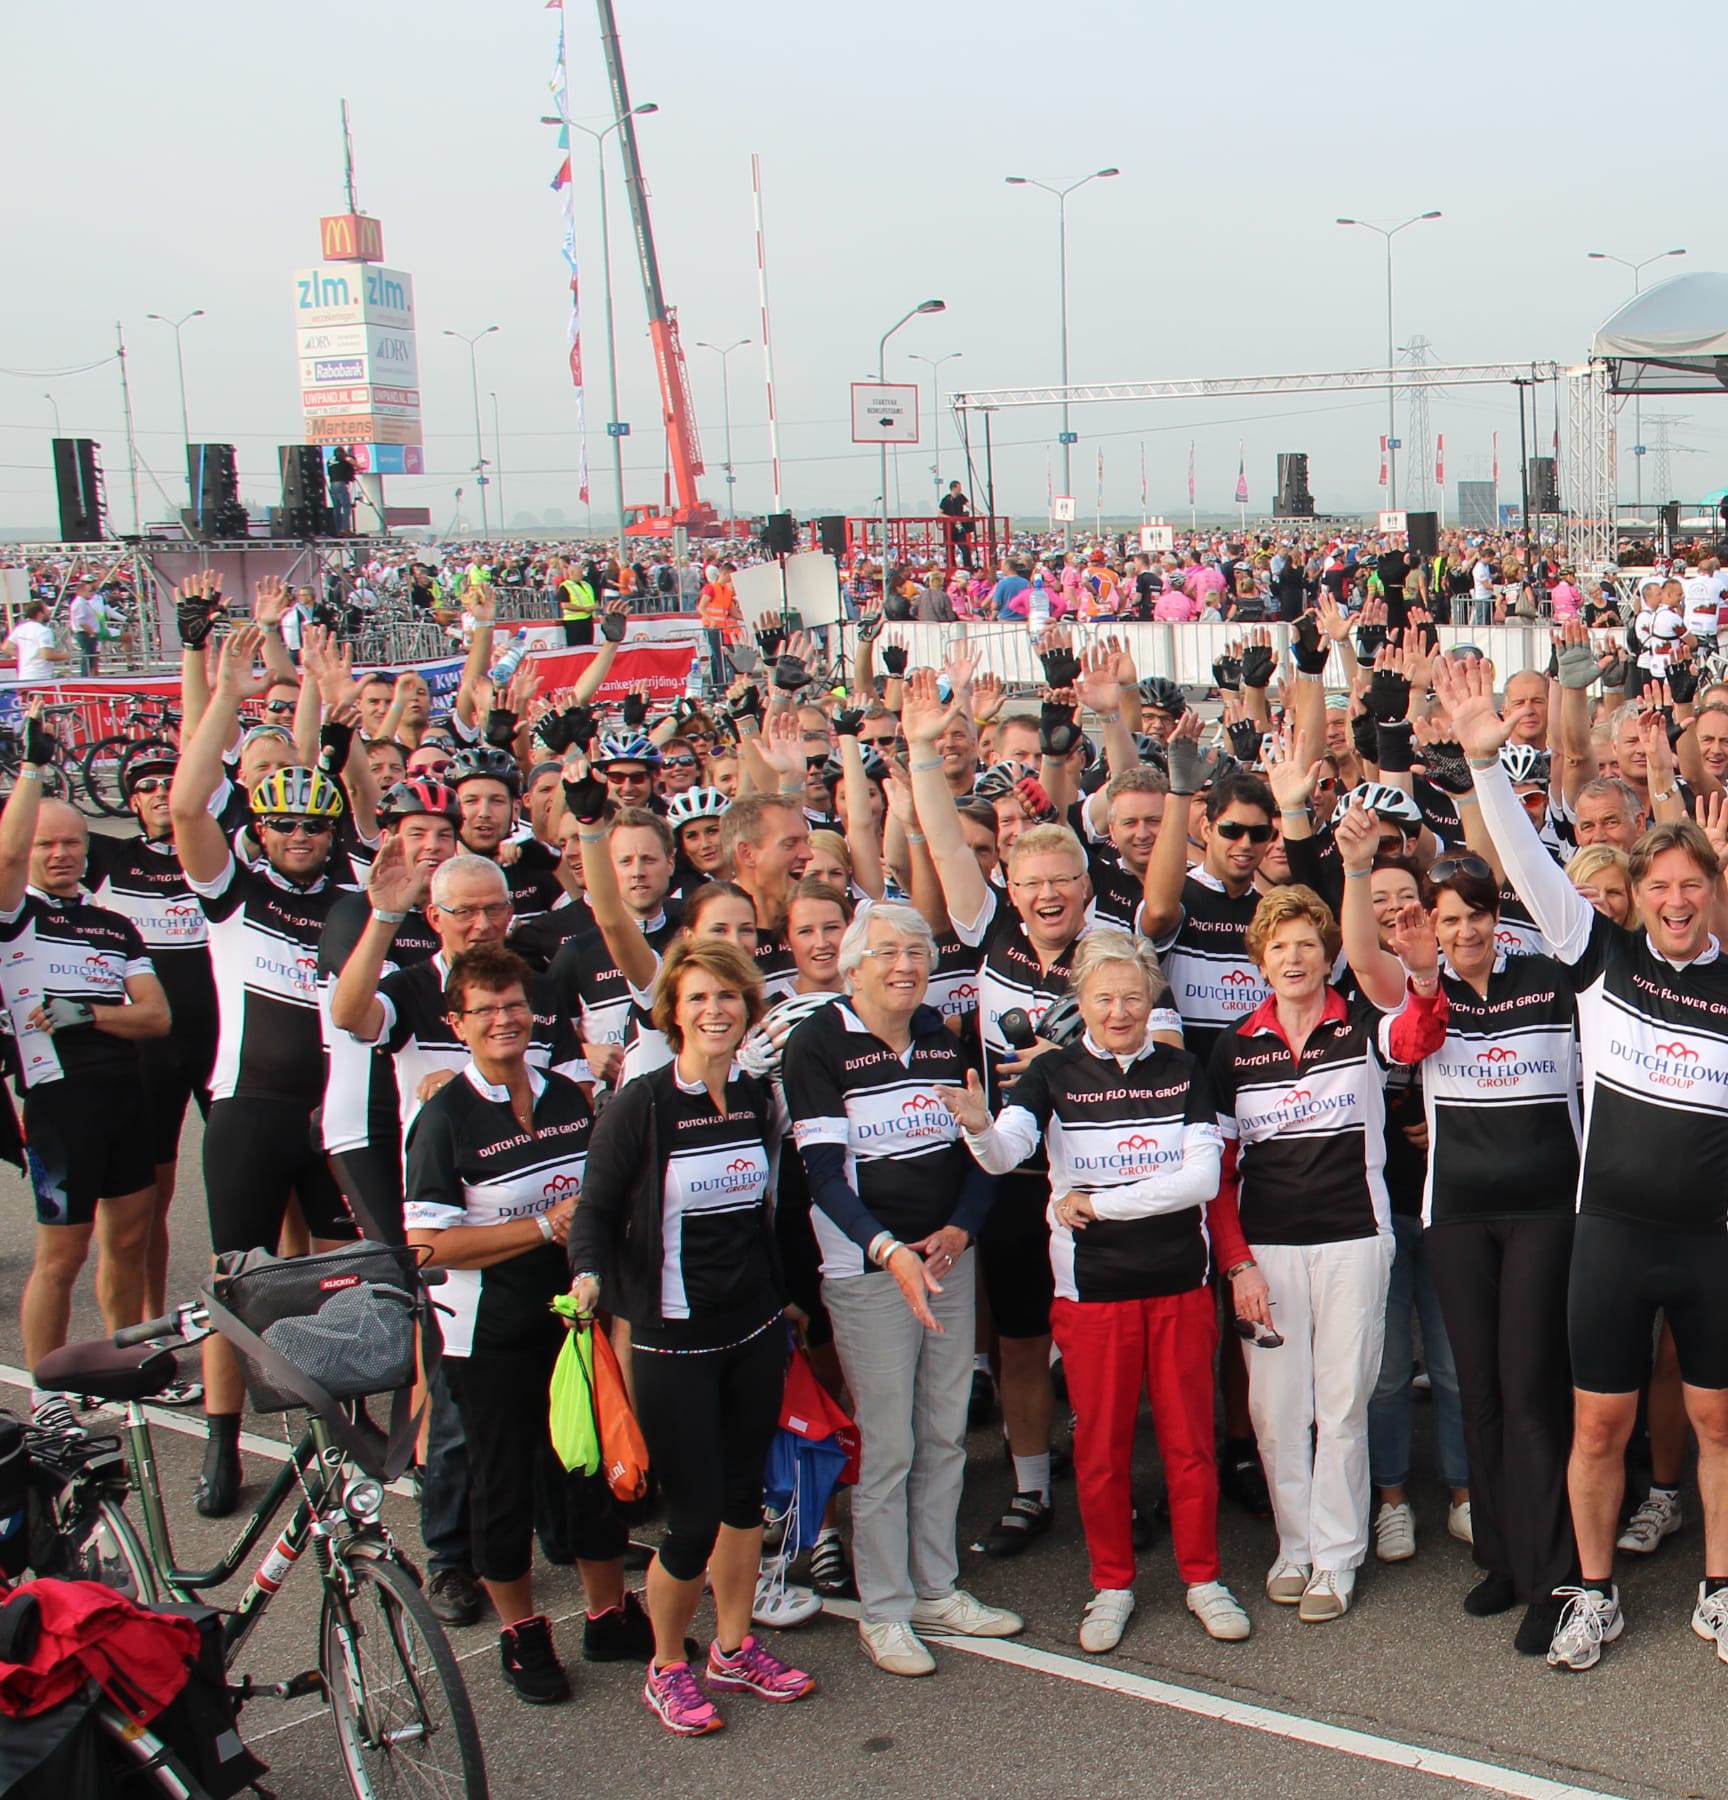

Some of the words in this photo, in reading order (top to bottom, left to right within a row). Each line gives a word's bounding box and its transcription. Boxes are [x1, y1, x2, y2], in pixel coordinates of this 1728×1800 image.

[316, 362, 362, 378] Rabobank
[313, 418, 373, 436] Martens
[50, 962, 98, 978] DUTCH
[255, 955, 309, 982] DUTCH
[596, 968, 625, 983] DUTC
[1186, 982, 1236, 1000] DUTCH
[1238, 986, 1271, 1001] FLOW
[1516, 990, 1556, 1008] GROUP
[1221, 1001, 1257, 1012] GROUP
[845, 1051, 881, 1072] DUTCH
[1235, 1053, 1271, 1067] DUTCH
[1610, 1039, 1667, 1074] DUTCH
[1438, 1062, 1492, 1078] DUTCH
[1497, 1059, 1557, 1076] FLOWER
[1477, 1076, 1520, 1088] GROUP
[1648, 1071, 1694, 1090] GROUP
[1241, 1110, 1289, 1131] DUTCH
[1292, 1093, 1356, 1118] FLOWER
[678, 1116, 708, 1130] DUTCH
[858, 1114, 919, 1139] DUTCH
[924, 1111, 963, 1128] FLOW
[1074, 1151, 1134, 1171] DUTCH
[1138, 1149, 1184, 1164] FLOW
[1118, 1163, 1160, 1177] GROUP
[691, 1175, 735, 1193] DUTCH
[739, 1170, 768, 1187] FLOW
[725, 1183, 756, 1194] GROUP
[498, 1195, 557, 1218] DUTCH
